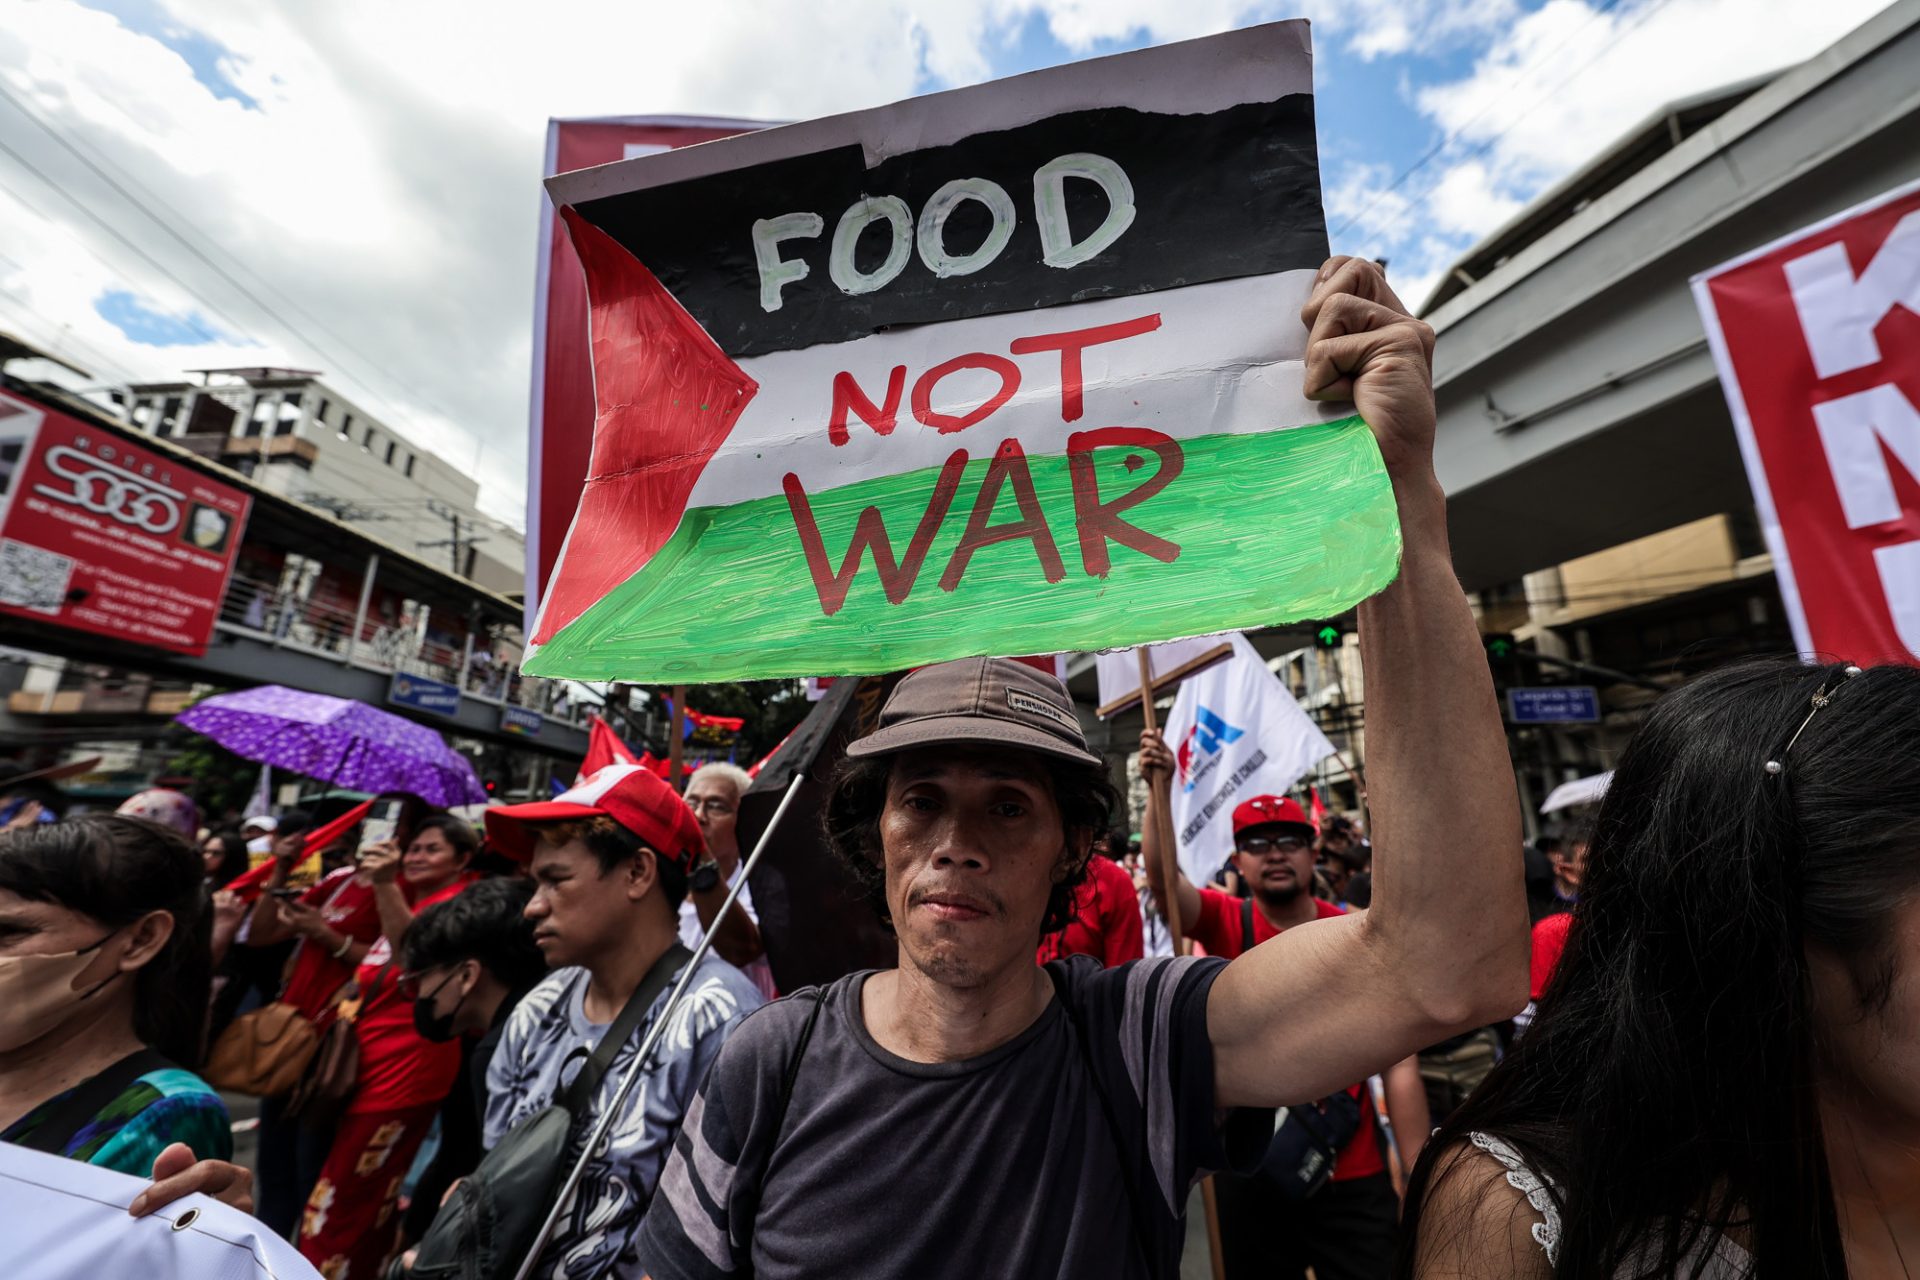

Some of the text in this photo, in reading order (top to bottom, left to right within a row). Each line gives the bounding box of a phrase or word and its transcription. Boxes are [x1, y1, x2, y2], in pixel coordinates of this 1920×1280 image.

[752, 152, 1136, 312] FOOD
[829, 313, 1162, 447] NOT
[34, 446, 188, 533] SOGO
[74, 436, 173, 485] HOTEL
[782, 427, 1184, 616] WAR
